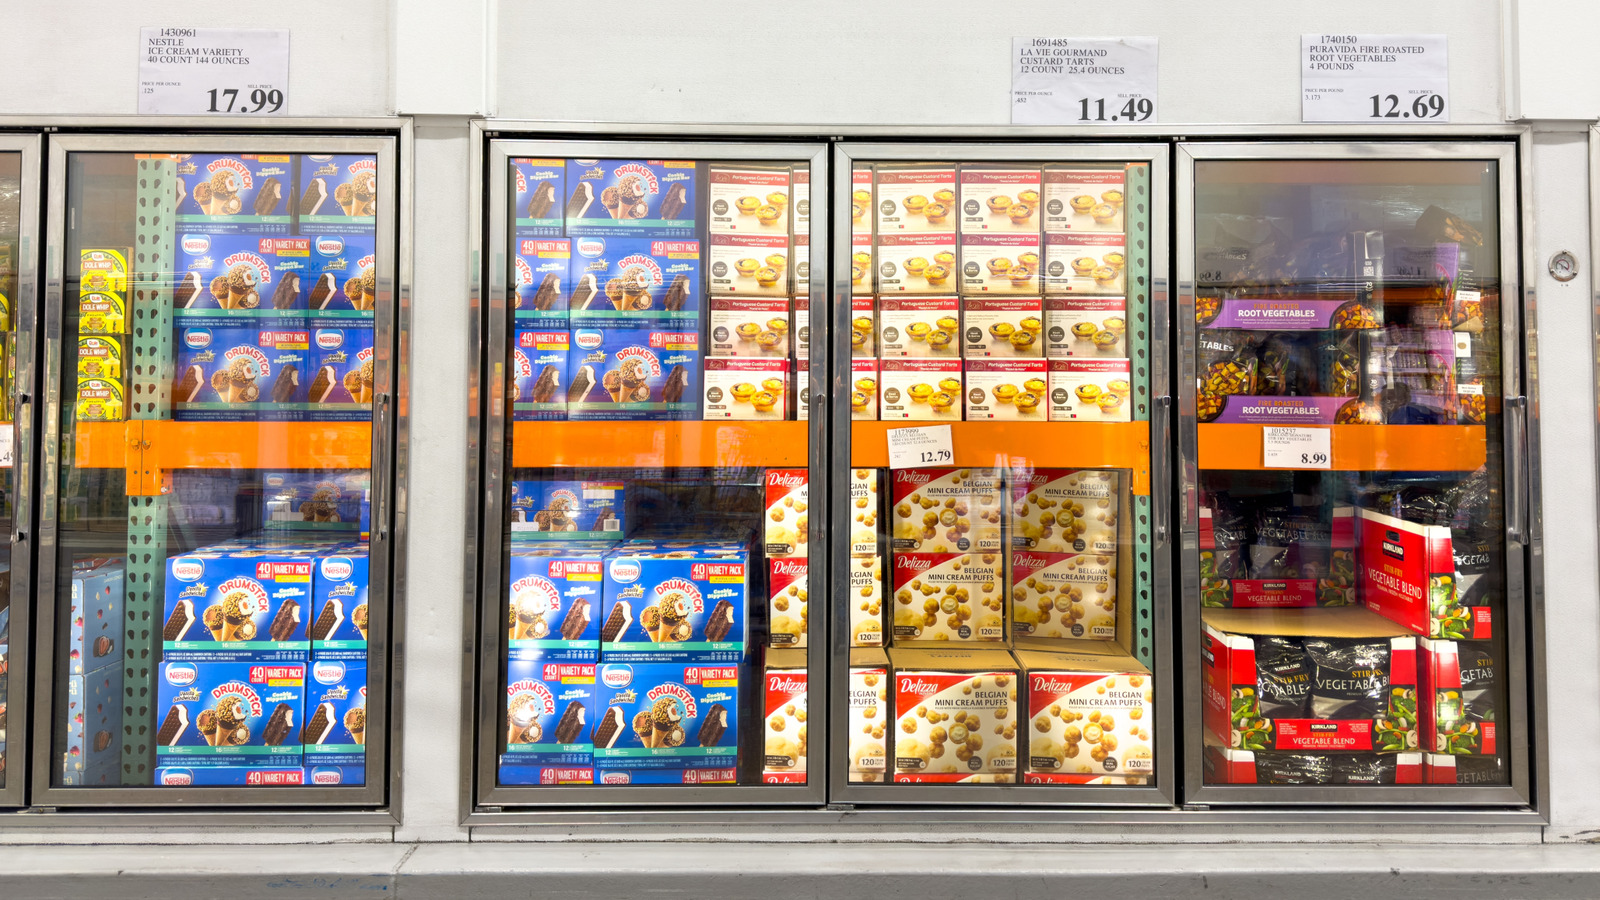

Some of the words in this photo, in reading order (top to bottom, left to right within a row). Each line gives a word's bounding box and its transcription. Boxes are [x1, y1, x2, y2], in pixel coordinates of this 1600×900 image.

[160, 28, 197, 38] 1430961
[149, 39, 184, 47] NESTLE
[1032, 38, 1068, 48] 1691485
[1320, 35, 1358, 45] 1740150
[148, 48, 163, 56] ICE
[166, 48, 200, 57] CREAM
[202, 49, 244, 57] VARIETY
[1021, 49, 1033, 57] LA
[1036, 49, 1051, 57] VIE
[1053, 49, 1108, 58] GOURMAND
[1309, 45, 1357, 54] PURAVIDA
[1359, 46, 1381, 54] FIRE
[1383, 46, 1425, 54] ROASTED
[148, 56, 158, 64] 40
[160, 57, 193, 65] COUNT
[196, 57, 209, 65] 144
[212, 58, 250, 66] OUNCES
[1020, 57, 1064, 66] CUSTARD
[1066, 58, 1095, 66] TARTS
[1309, 54, 1335, 62] ROOT
[1337, 54, 1397, 63] VEGETABLES
[1020, 66, 1029, 74] 12
[1032, 66, 1064, 74] COUNT
[1068, 67, 1085, 75] 25.4
[1088, 67, 1125, 75] OUNCES
[1317, 62, 1355, 71] POUNDS
[207, 89, 284, 113] 17.99
[1369, 94, 1445, 118] 12.69
[1078, 98, 1154, 122] 11.49
[207, 158, 253, 190] DRUMSTICK
[614, 164, 659, 195] DRUMSTICK
[224, 252, 271, 283] DRUMSTICK
[618, 255, 663, 286] DRUMSTICK
[82, 303, 95, 311] DOLE
[95, 303, 109, 311] WHIP
[261, 331, 272, 342] 40
[275, 333, 293, 342] VARIETY
[293, 333, 307, 342] PACK
[521, 334, 533, 343] 40
[536, 335, 554, 343] VARIETY
[555, 335, 567, 343] PACK
[79, 348, 92, 356] DOLE
[93, 348, 107, 356] WHIP
[224, 345, 270, 377] DRUMSTICK
[615, 346, 661, 378] DRUMSTICK
[1266, 407, 1320, 415] VEGETABLES
[921, 450, 951, 463] 12.79
[1301, 453, 1327, 464] 8.99
[769, 472, 804, 487] Delizza
[897, 555, 932, 570] Delizza
[1013, 554, 1047, 569] Delizza
[258, 563, 271, 574] 40
[274, 565, 295, 574] VARIETY
[296, 565, 309, 574] PACK
[692, 564, 705, 575] 40
[708, 565, 727, 575] VARIETY
[727, 565, 742, 575] PACK
[1367, 568, 1400, 591] VEGETABLE
[1401, 581, 1422, 599] BLEND
[218, 577, 270, 613] DRUMSTICK
[654, 579, 704, 614] DRUMSTICK
[251, 667, 264, 678] 40
[267, 668, 289, 678] VARIETY
[289, 668, 303, 678] PACK
[685, 667, 698, 679] 40
[701, 669, 722, 679] VARIETY
[722, 669, 736, 679] PACK
[1352, 670, 1371, 678] STIR
[900, 678, 939, 695] Delizza
[1034, 677, 1072, 694] Delizza
[211, 682, 262, 717] DRUMSTICK
[647, 683, 697, 718] DRUMSTICK
[985, 698, 1008, 706] PUFFS
[1292, 737, 1331, 745] VEGETABLE
[1333, 737, 1356, 745] BLEND
[993, 759, 1006, 767] 120
[1128, 760, 1141, 768] 120
